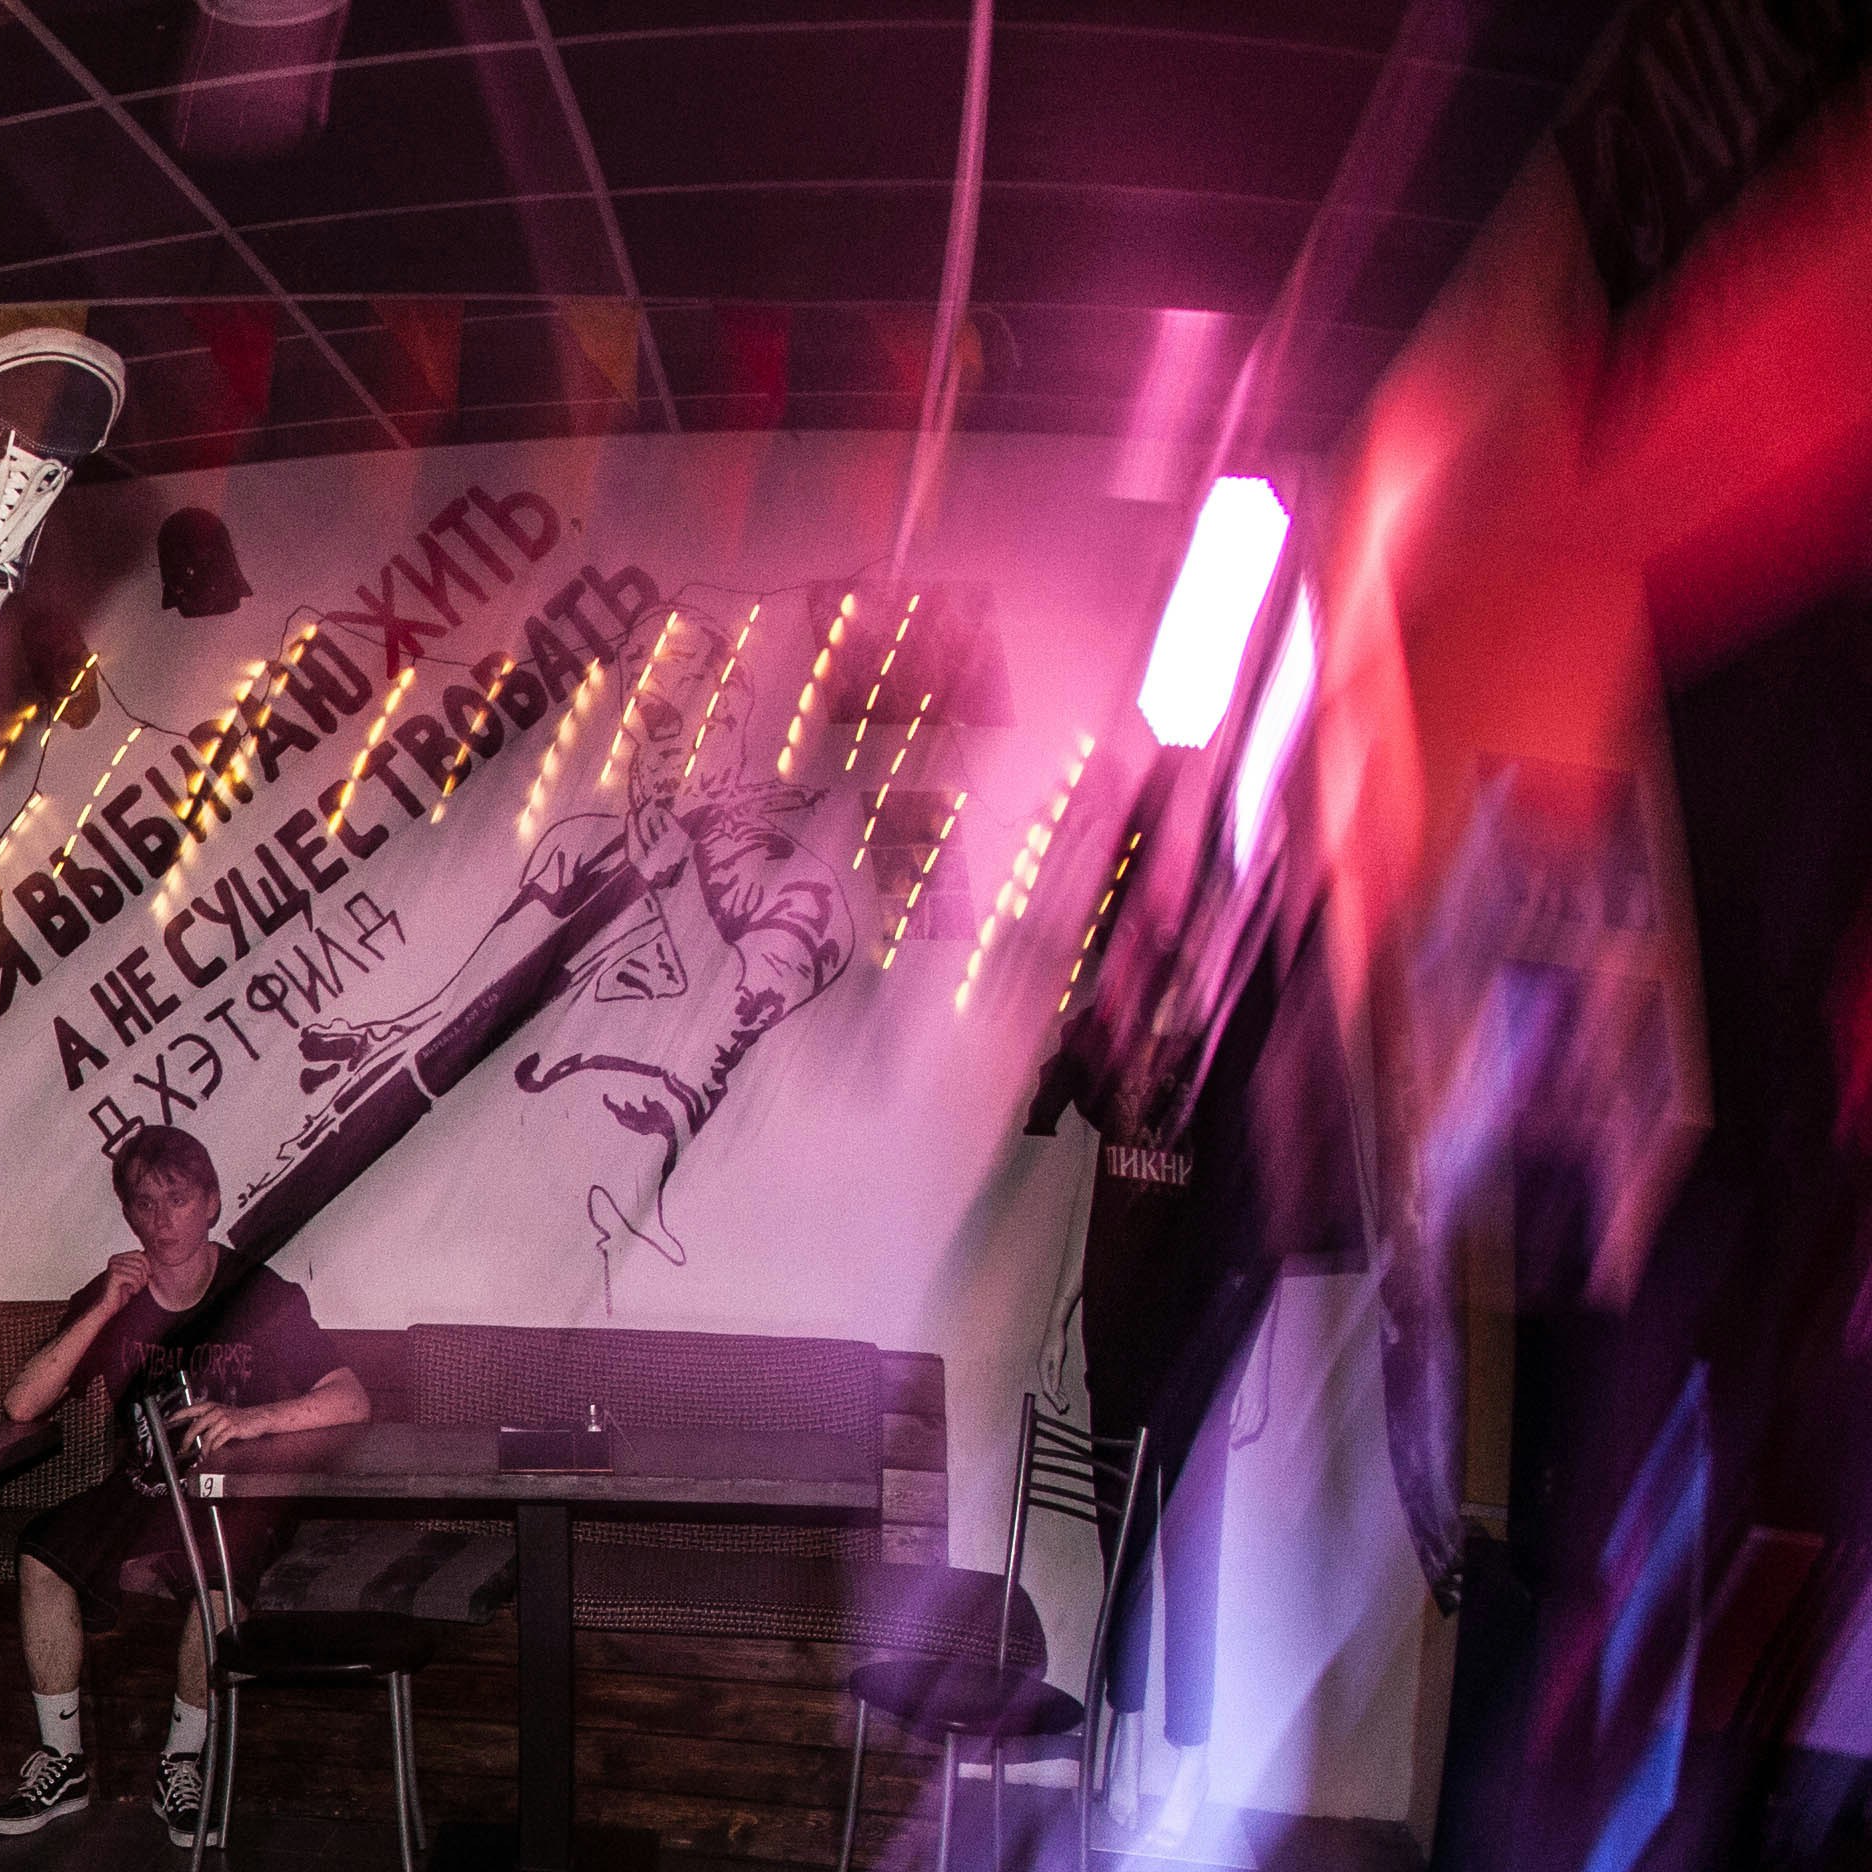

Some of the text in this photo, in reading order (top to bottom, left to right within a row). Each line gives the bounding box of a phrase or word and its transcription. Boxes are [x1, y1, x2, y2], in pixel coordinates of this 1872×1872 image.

[13, 628, 373, 959] ВЫБИРАЮ
[54, 564, 660, 1092] А НЕ СУЩЕСТВОВАТЬ
[202, 1477, 215, 1498] 9
